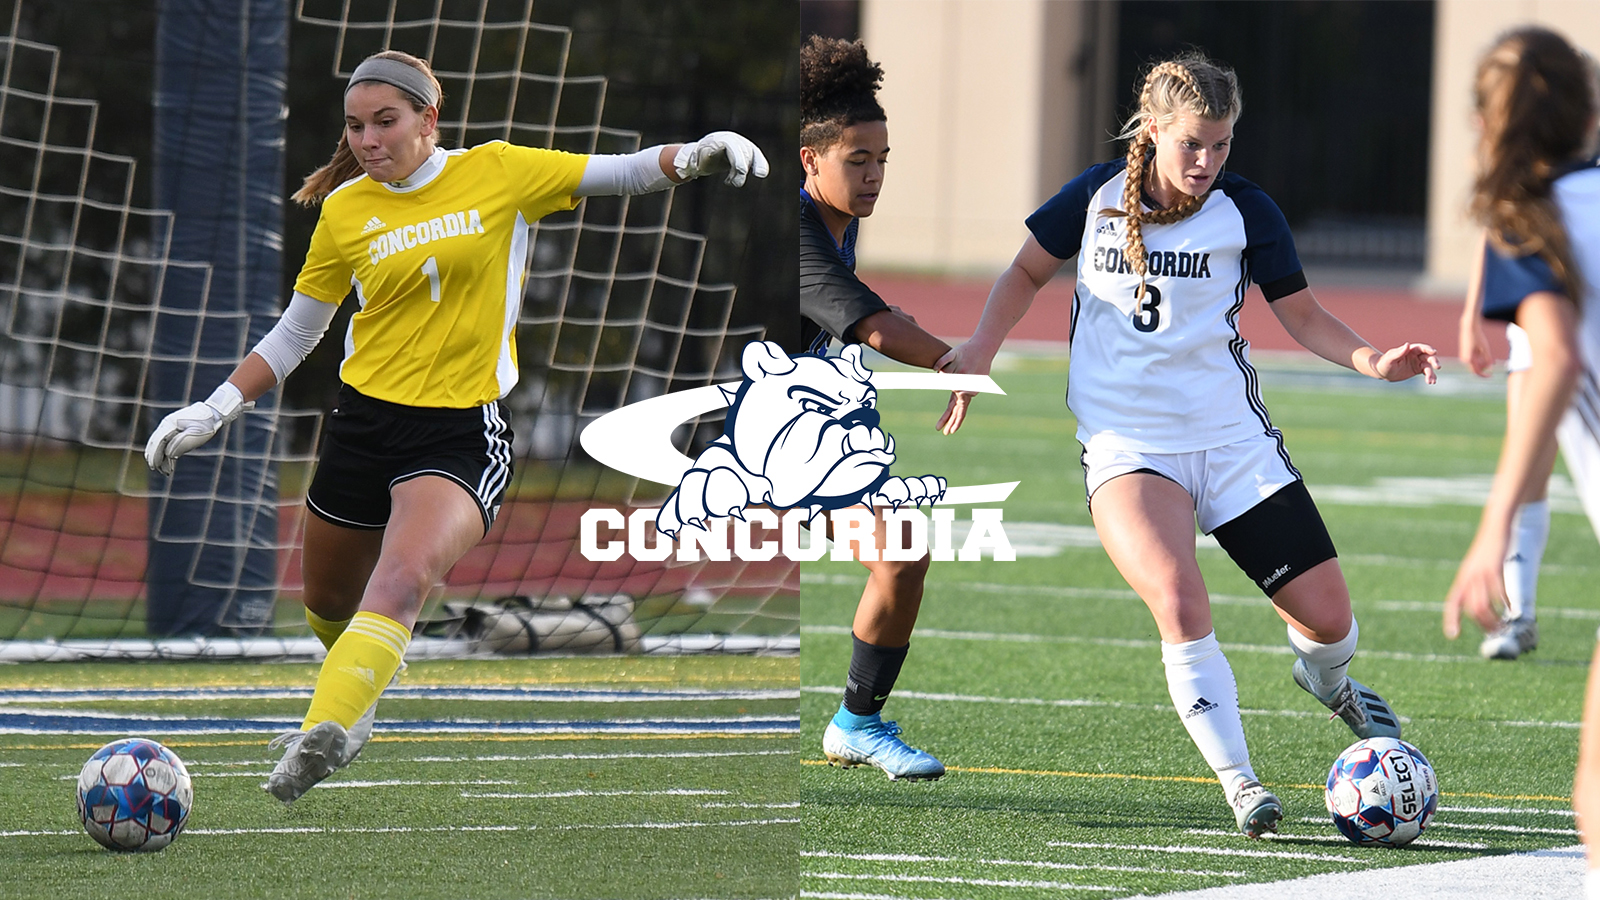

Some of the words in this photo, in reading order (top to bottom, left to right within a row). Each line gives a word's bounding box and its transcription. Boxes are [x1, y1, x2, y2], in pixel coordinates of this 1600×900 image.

[368, 209, 485, 266] CONCORDIA
[421, 256, 441, 303] 1
[1094, 246, 1211, 279] CONORDIA
[1132, 284, 1162, 333] 3
[1185, 702, 1219, 719] adidas
[1389, 755, 1416, 815] SELECT
